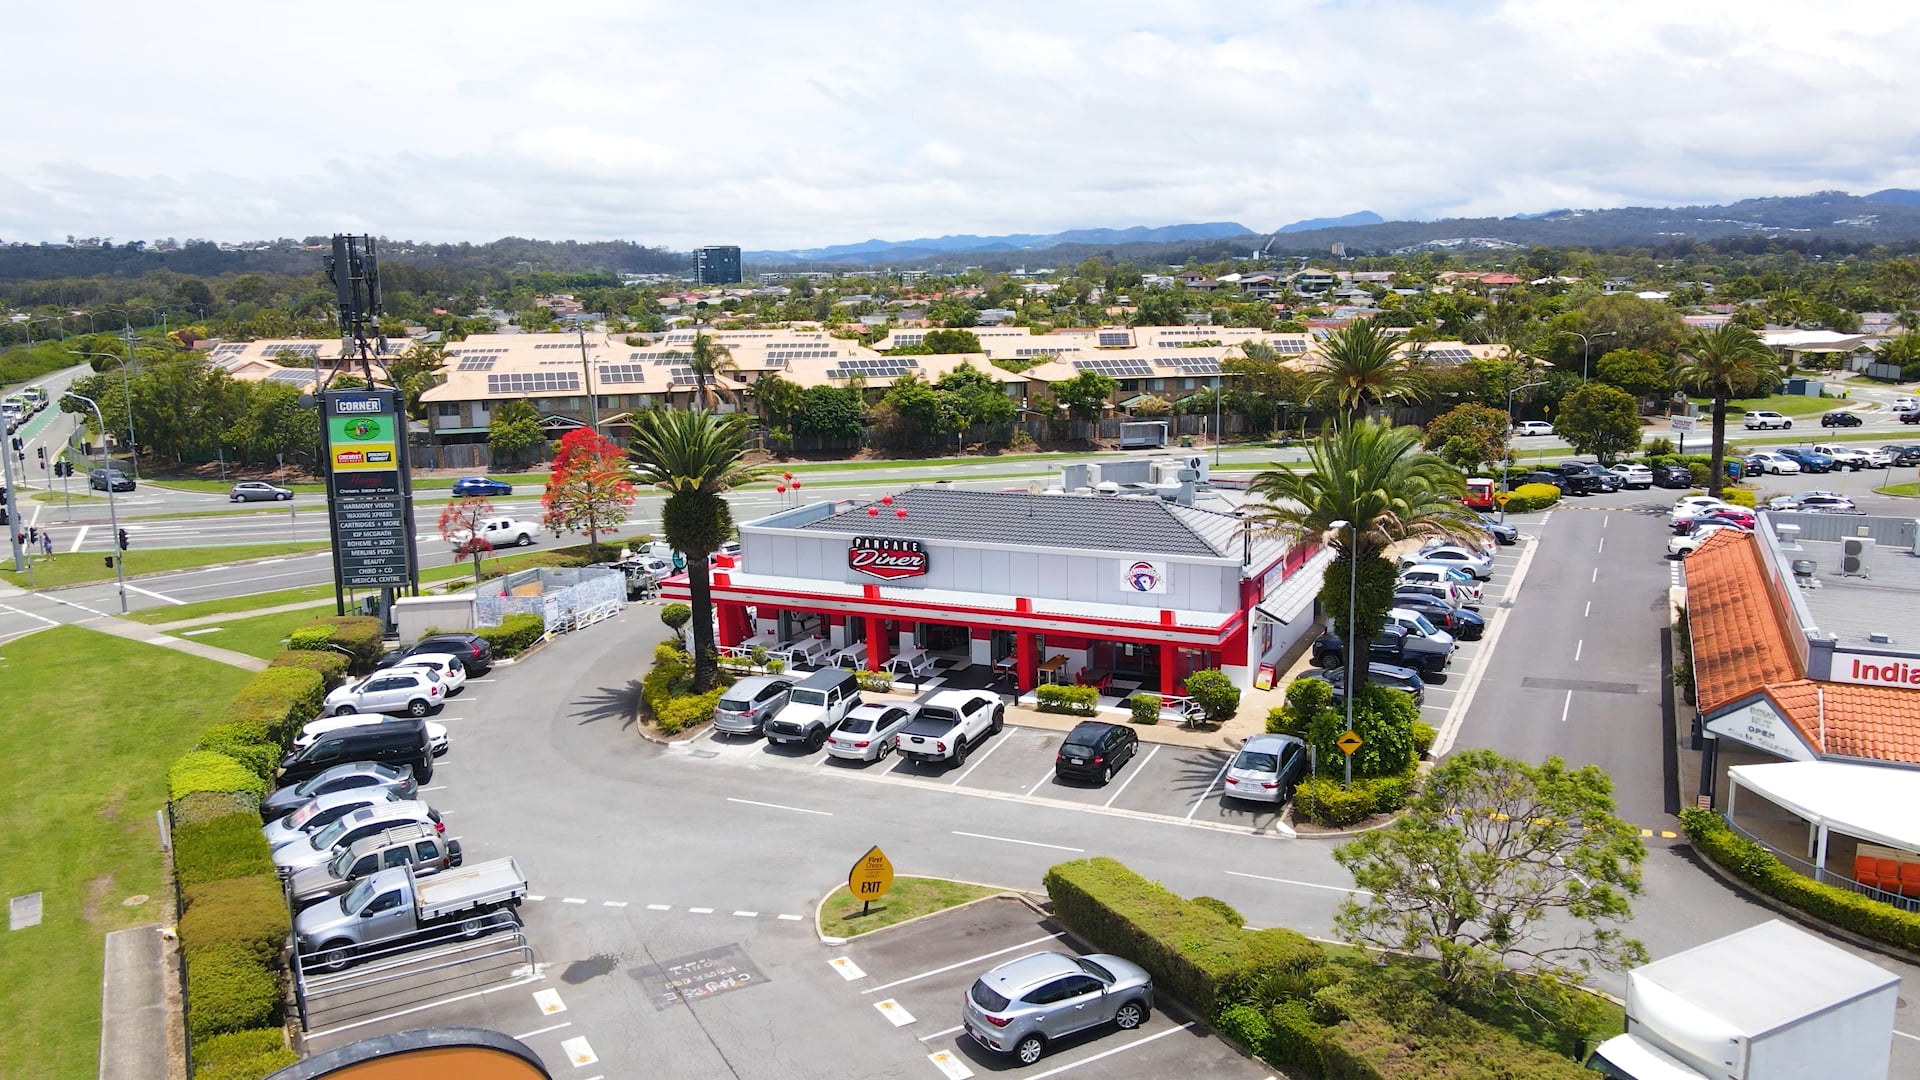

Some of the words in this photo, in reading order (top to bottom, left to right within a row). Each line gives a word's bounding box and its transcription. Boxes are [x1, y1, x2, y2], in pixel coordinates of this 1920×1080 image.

[339, 401, 378, 411] CORNER
[856, 538, 918, 551] PANCAKE
[853, 549, 924, 567] Diner
[862, 882, 882, 892] EXIT
